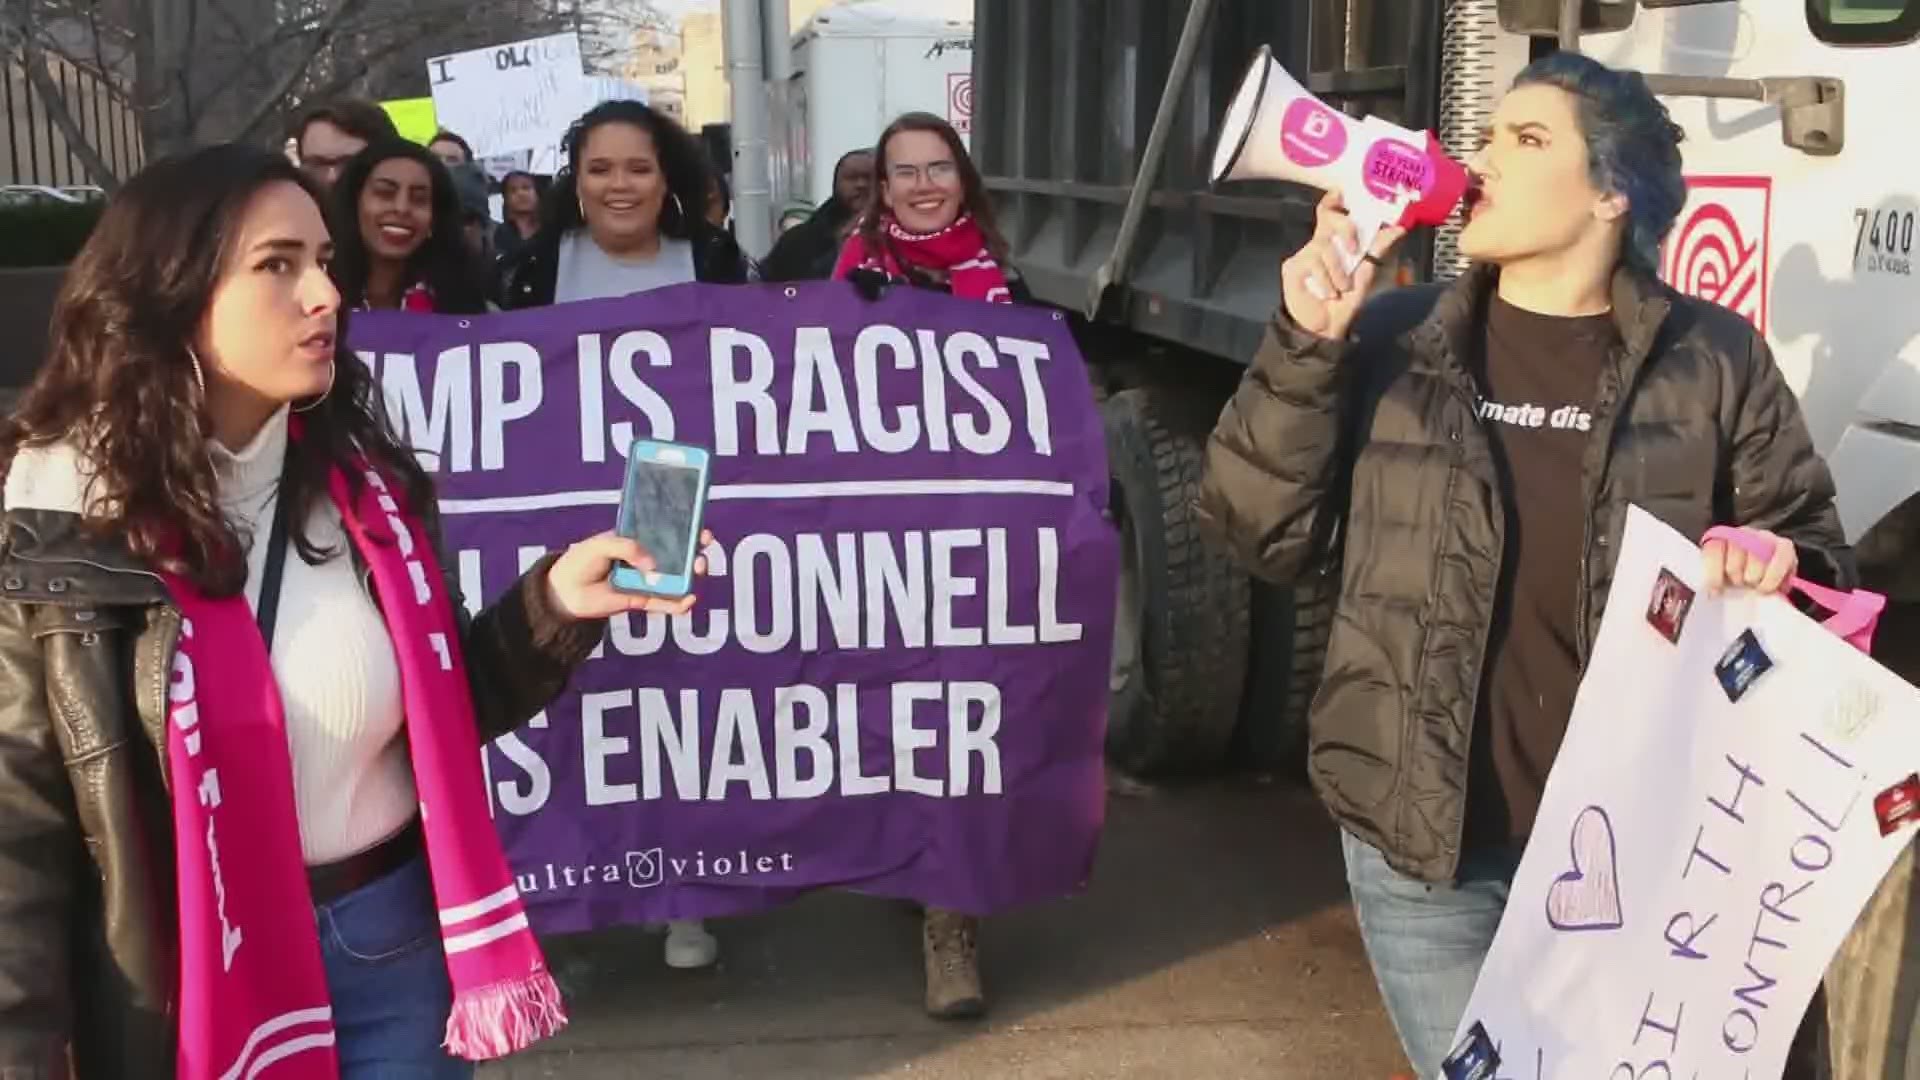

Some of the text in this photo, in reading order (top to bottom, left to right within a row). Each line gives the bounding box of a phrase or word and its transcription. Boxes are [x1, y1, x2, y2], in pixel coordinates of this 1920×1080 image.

[1853, 208, 1914, 262] 7400
[355, 325, 1053, 473] MP IS RACIST
[1478, 395, 1546, 428] mate
[581, 681, 1002, 806] ENABLER
[516, 850, 794, 893] ultra violet
